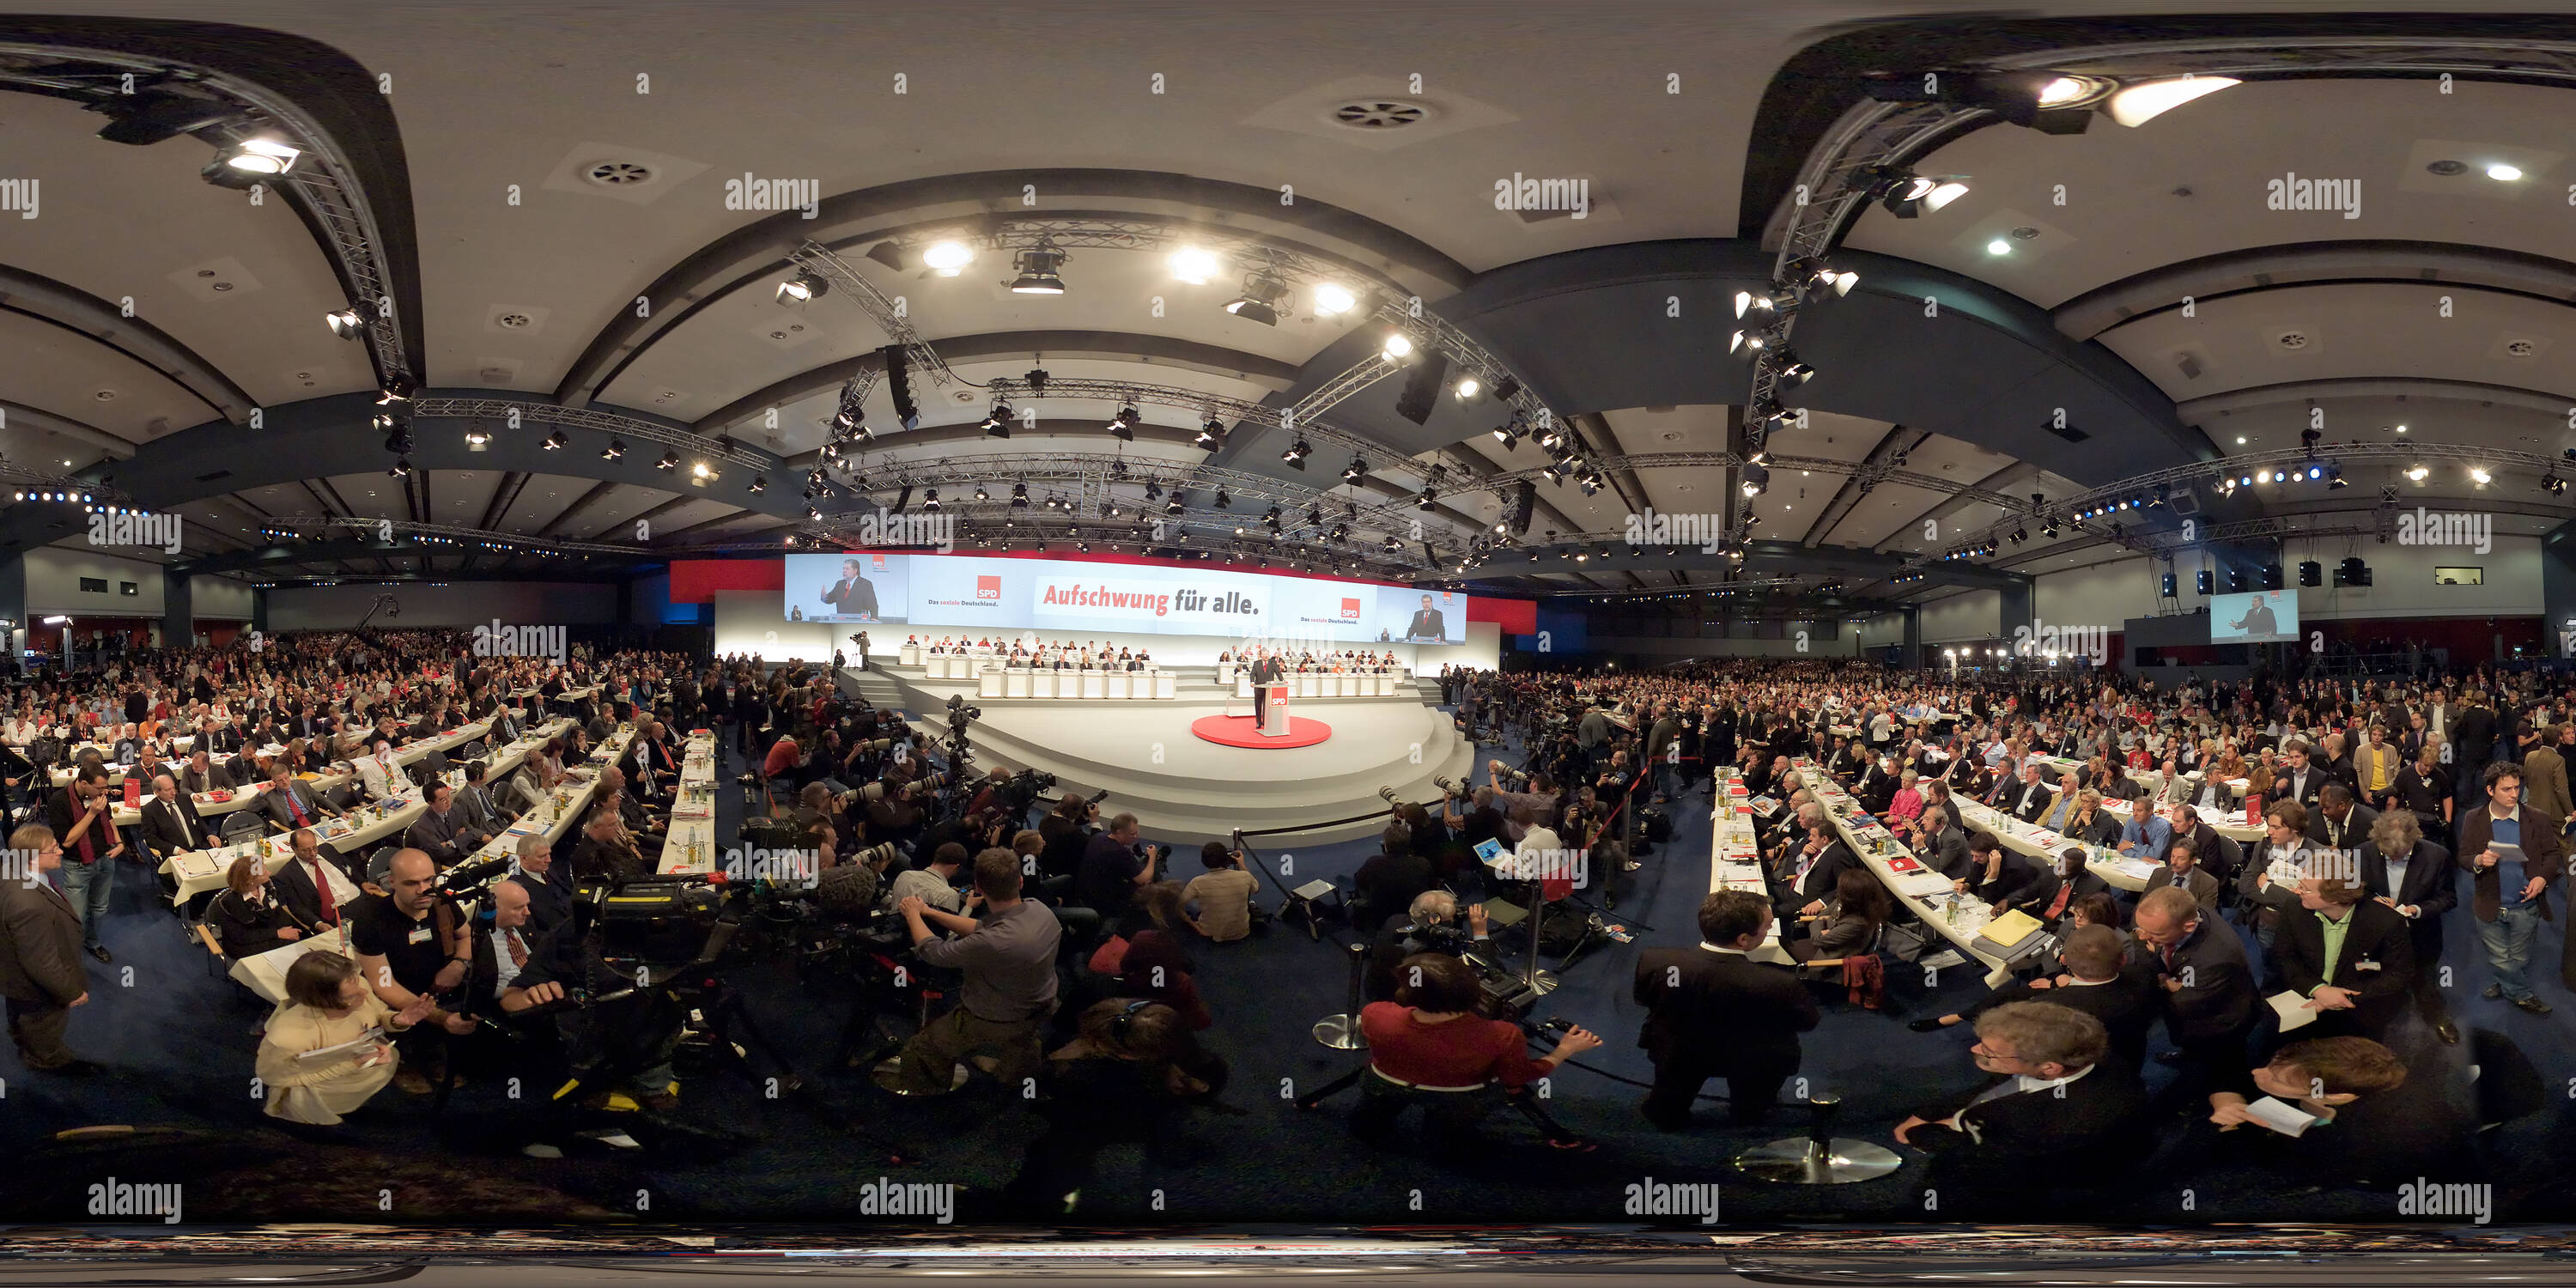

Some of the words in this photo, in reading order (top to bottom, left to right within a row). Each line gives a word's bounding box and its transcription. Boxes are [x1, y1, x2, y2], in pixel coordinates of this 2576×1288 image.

[978, 589, 998, 598] SPD
[1043, 584, 1169, 617] Aufschwung
[1175, 589, 1207, 611] für
[1212, 591, 1259, 615] alle.
[1342, 609, 1358, 617] SPD
